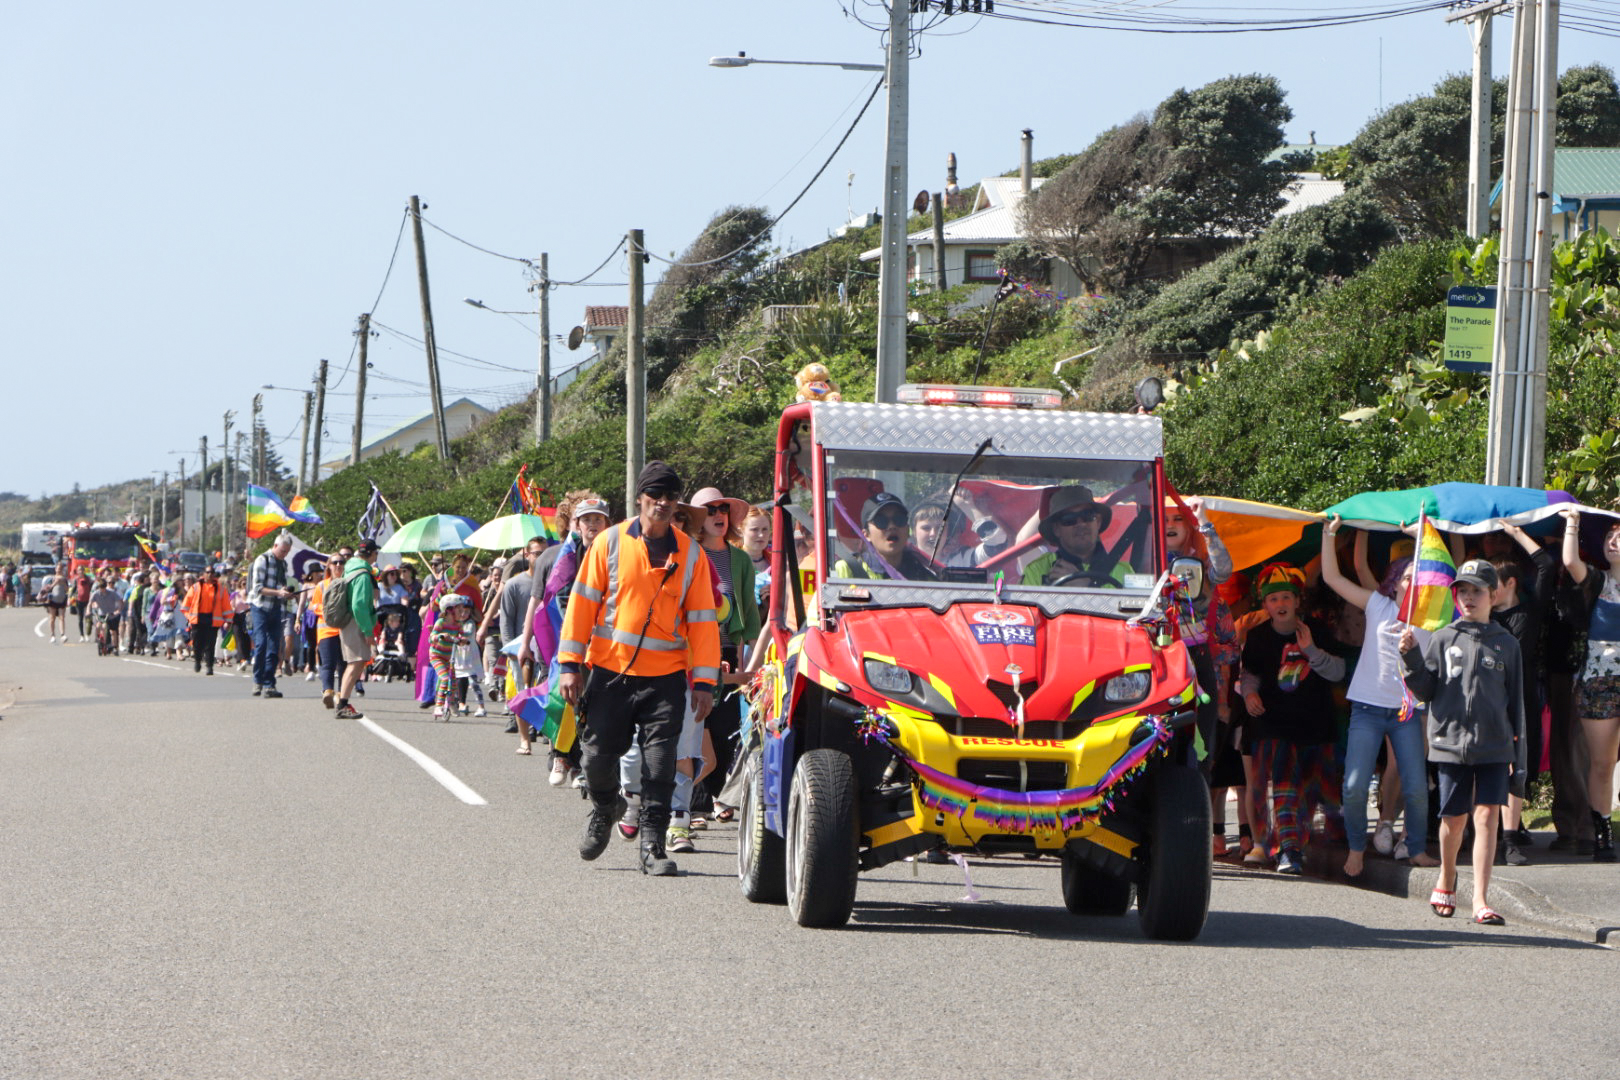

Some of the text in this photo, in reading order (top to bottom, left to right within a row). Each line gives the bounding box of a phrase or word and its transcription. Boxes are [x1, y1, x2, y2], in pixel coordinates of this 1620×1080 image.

[1450, 294, 1477, 302] metlink
[1450, 316, 1492, 326] The Parade
[1449, 350, 1472, 359] 1419
[977, 627, 1034, 638] FIRE
[962, 737, 1066, 749] RESCUE
